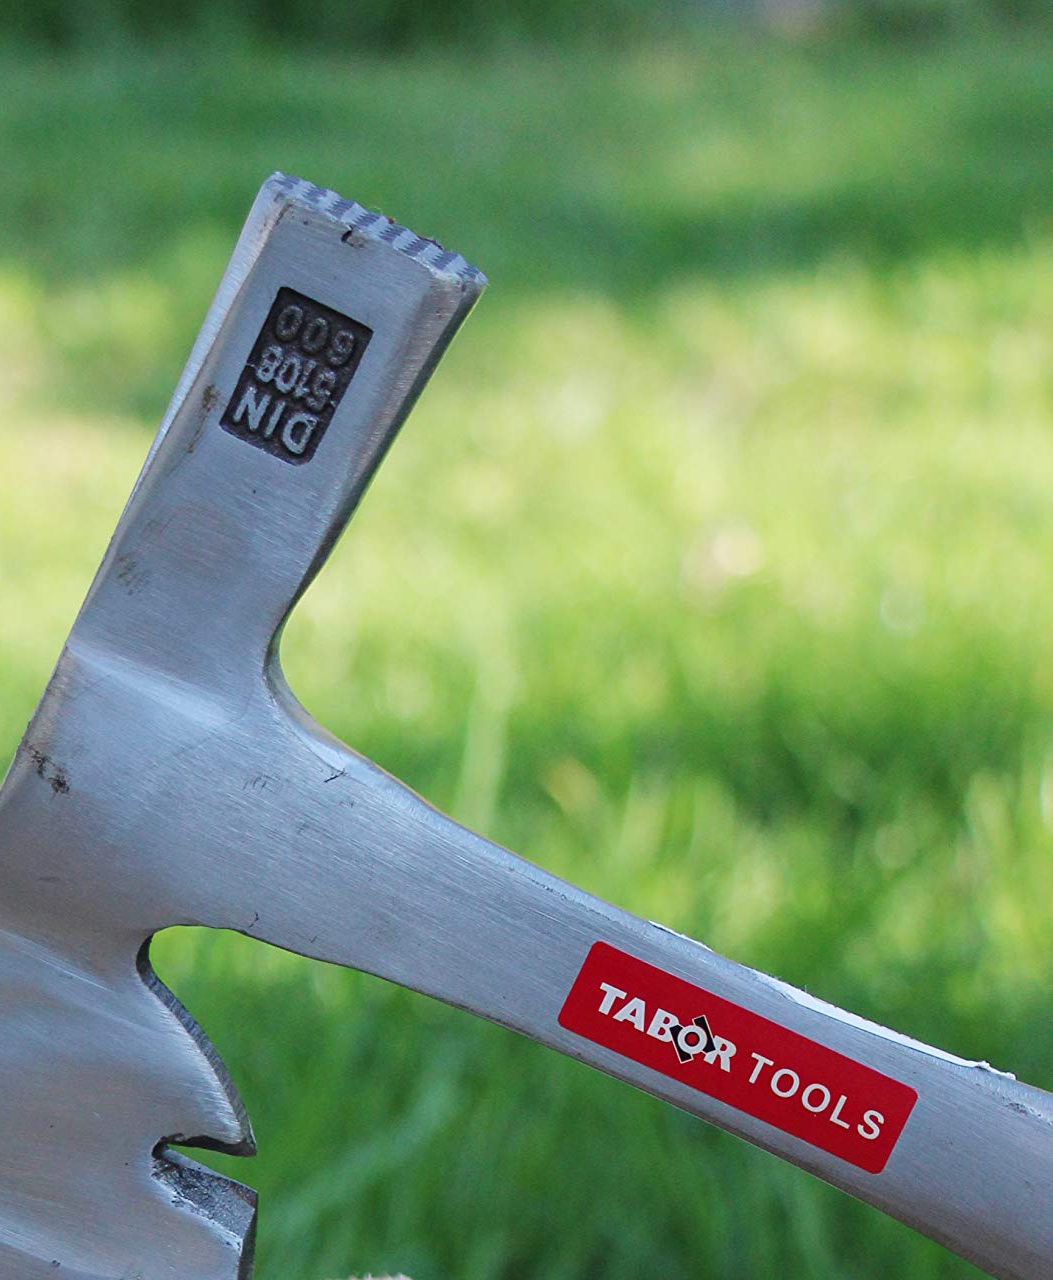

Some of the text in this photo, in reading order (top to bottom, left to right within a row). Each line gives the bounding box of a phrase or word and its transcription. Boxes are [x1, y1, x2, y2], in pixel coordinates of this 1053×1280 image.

[275, 304, 355, 366] 600
[255, 345, 338, 410] 5108
[233, 386, 320, 455] DIN
[597, 982, 885, 1140] TABOR TOOLS
